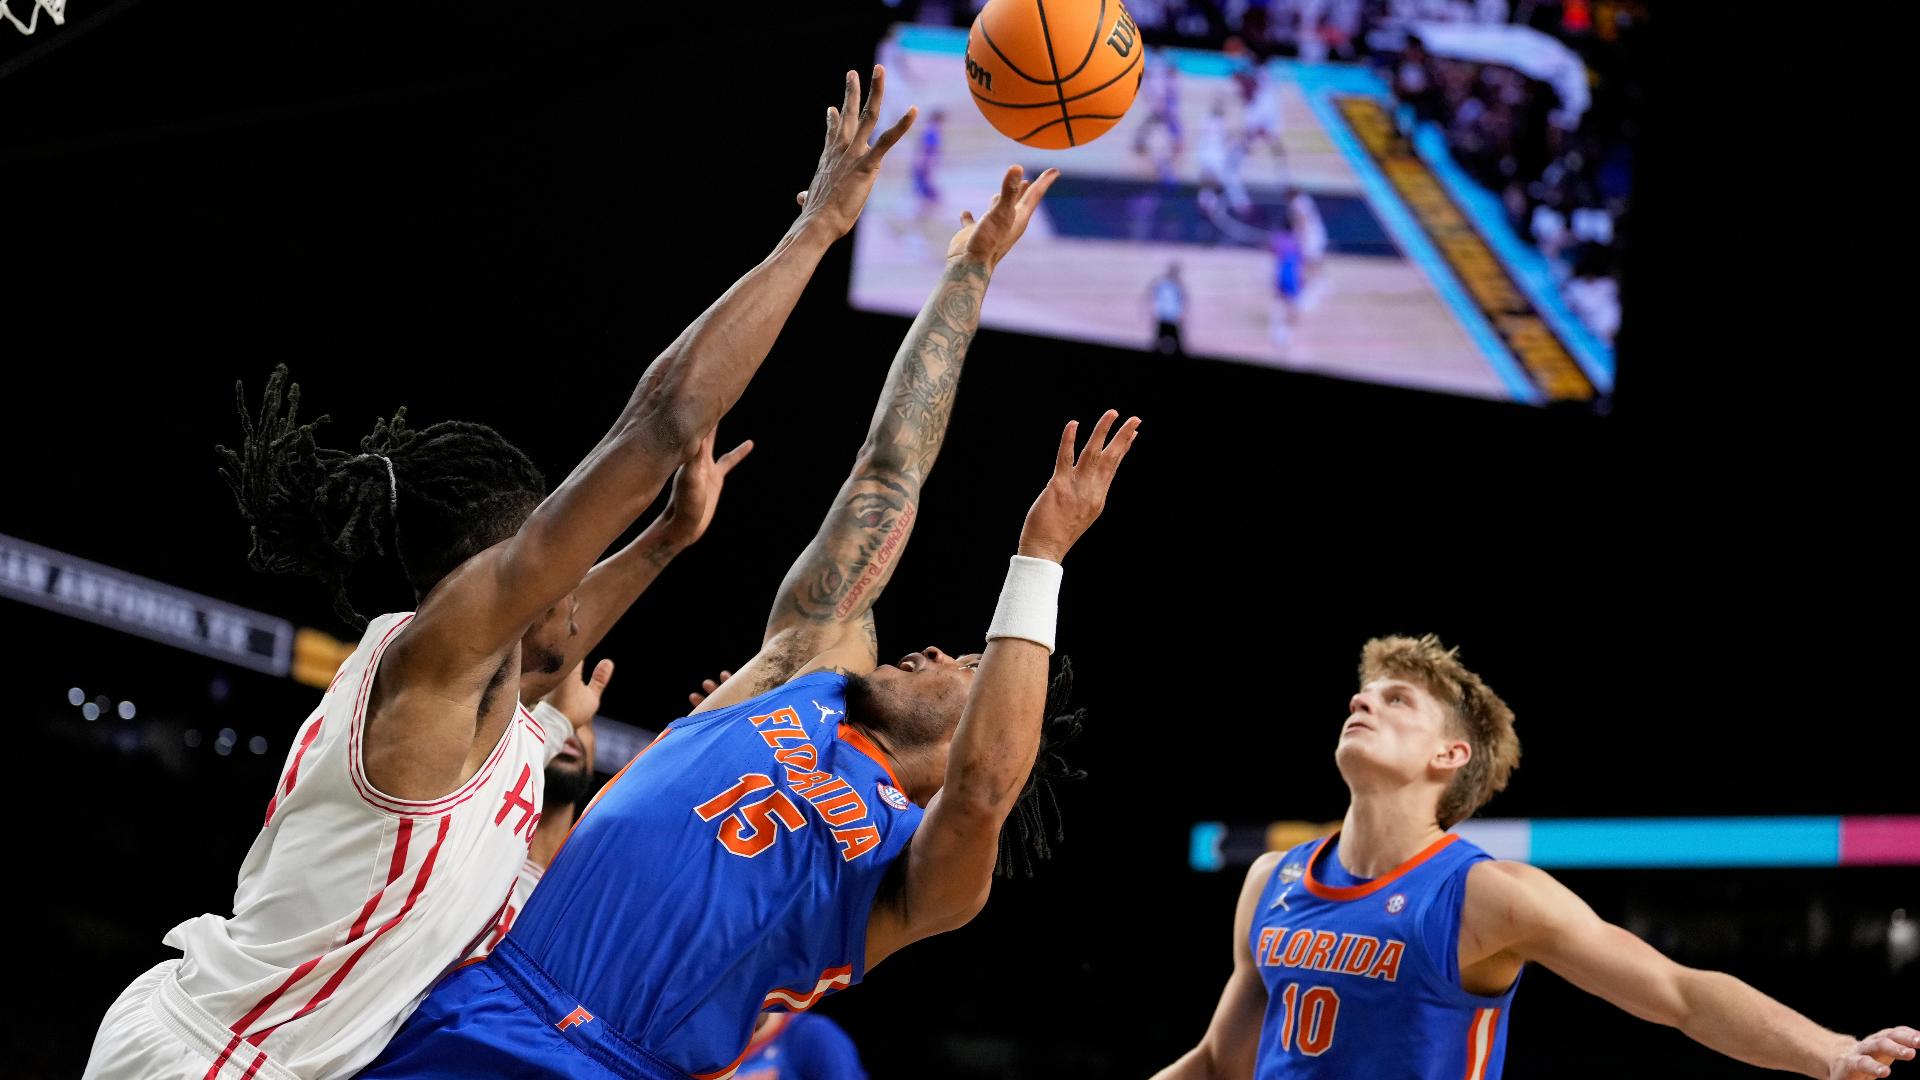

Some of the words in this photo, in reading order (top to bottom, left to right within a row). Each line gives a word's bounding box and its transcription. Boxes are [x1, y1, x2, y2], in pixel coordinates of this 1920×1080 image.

[877, 503, 915, 566] DETERMINED
[836, 575, 871, 618] SUCCEED
[868, 563, 884, 577] TO
[495, 763, 542, 850] Ho
[747, 704, 881, 862] FLORIDA
[693, 773, 808, 858] 15
[1256, 927, 1406, 982] FLORIDA
[555, 1005, 594, 1032] F
[1281, 982, 1340, 1057] 10
